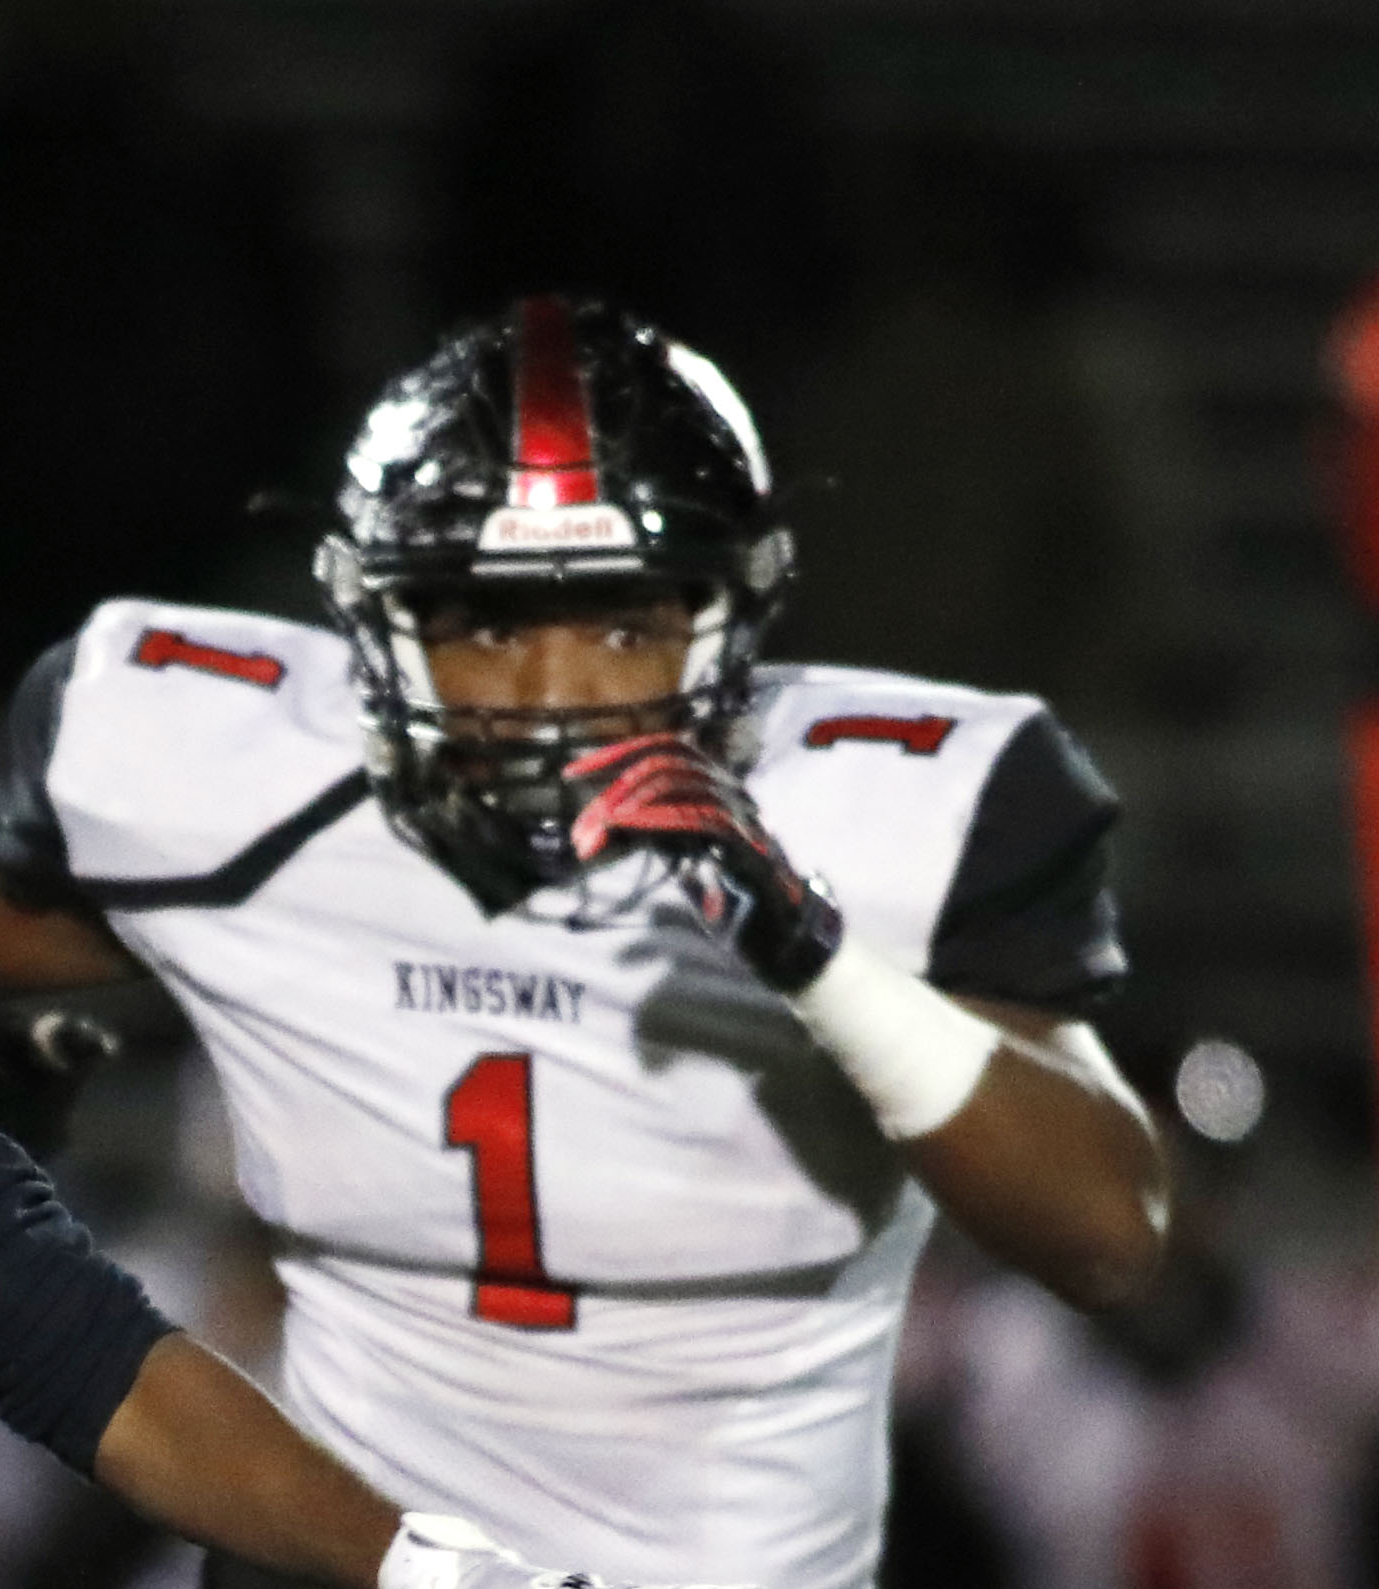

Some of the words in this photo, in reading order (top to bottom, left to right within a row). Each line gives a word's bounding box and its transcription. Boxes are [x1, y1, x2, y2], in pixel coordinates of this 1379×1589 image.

[129, 628, 288, 692] 1
[804, 713, 958, 755] 1
[393, 959, 587, 1024] KINGSWAY
[444, 1051, 578, 1333] 1
